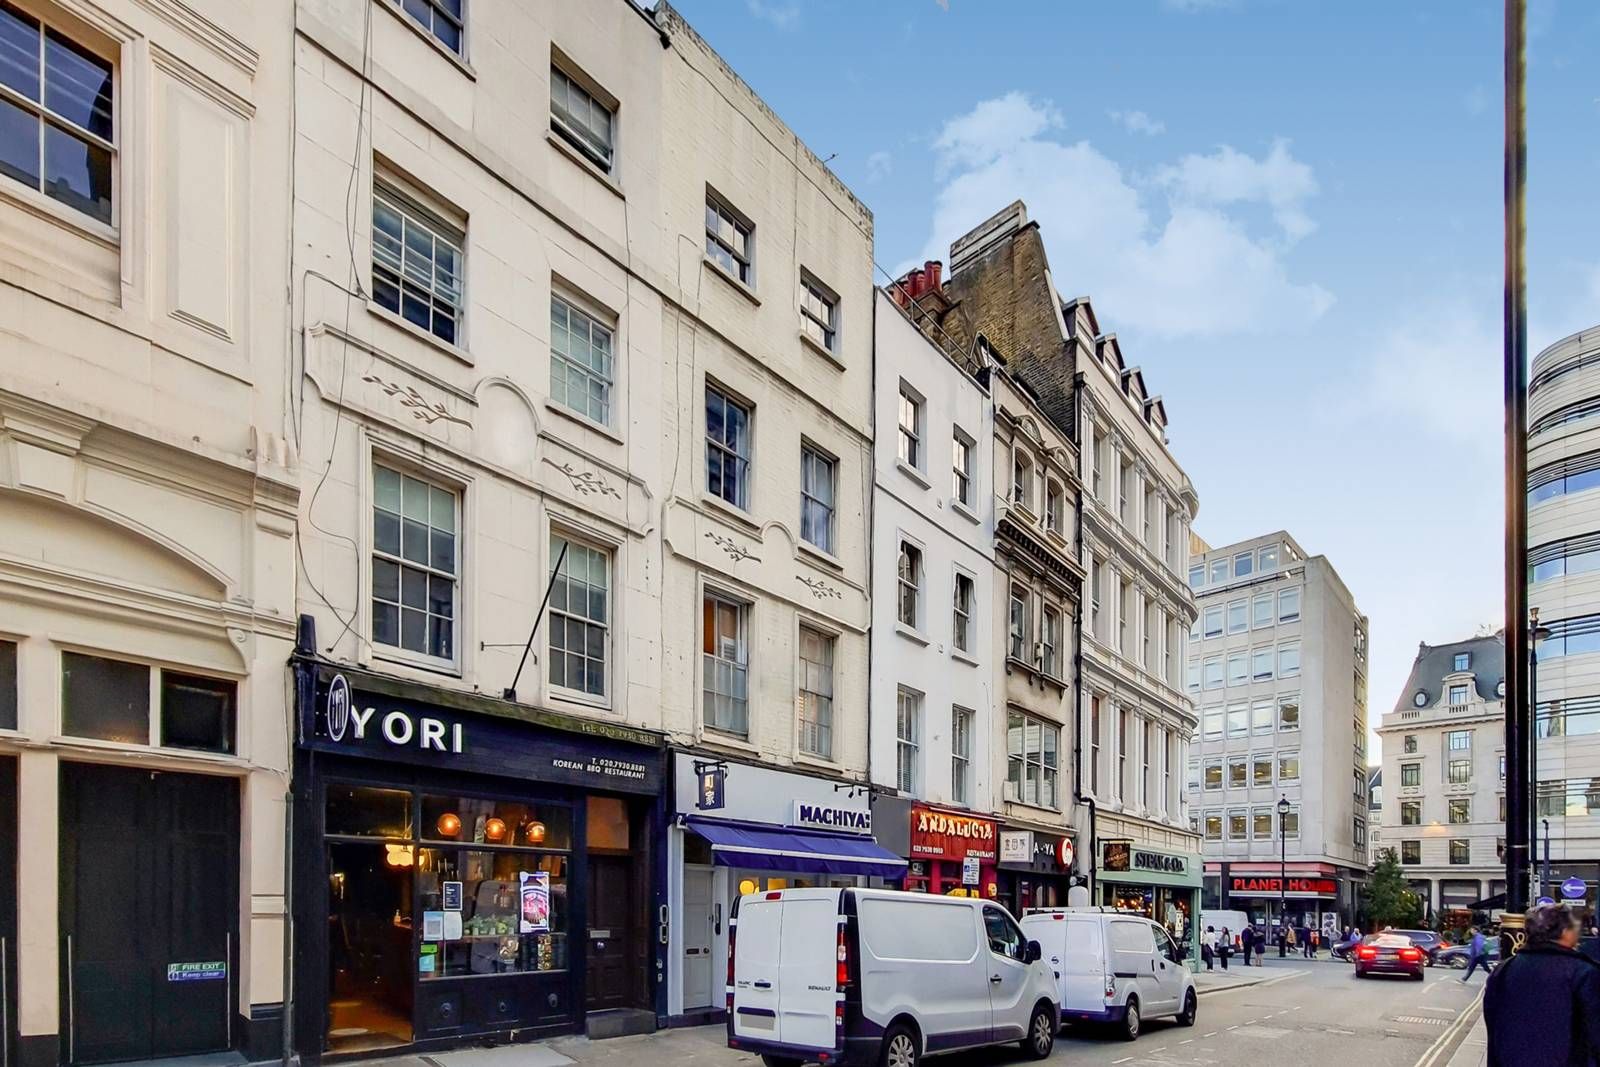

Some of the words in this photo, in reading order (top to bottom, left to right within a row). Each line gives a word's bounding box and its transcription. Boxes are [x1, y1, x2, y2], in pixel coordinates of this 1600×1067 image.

[351, 704, 462, 753] YORI
[552, 759, 583, 770] KOREAN
[587, 765, 601, 773] BBQ
[604, 767, 645, 779] RESTAURANT
[800, 805, 866, 828] MACHIYA
[918, 812, 993, 839] ANDALUCIA
[1135, 852, 1164, 871] STEAK
[1233, 879, 1283, 891] PLANET
